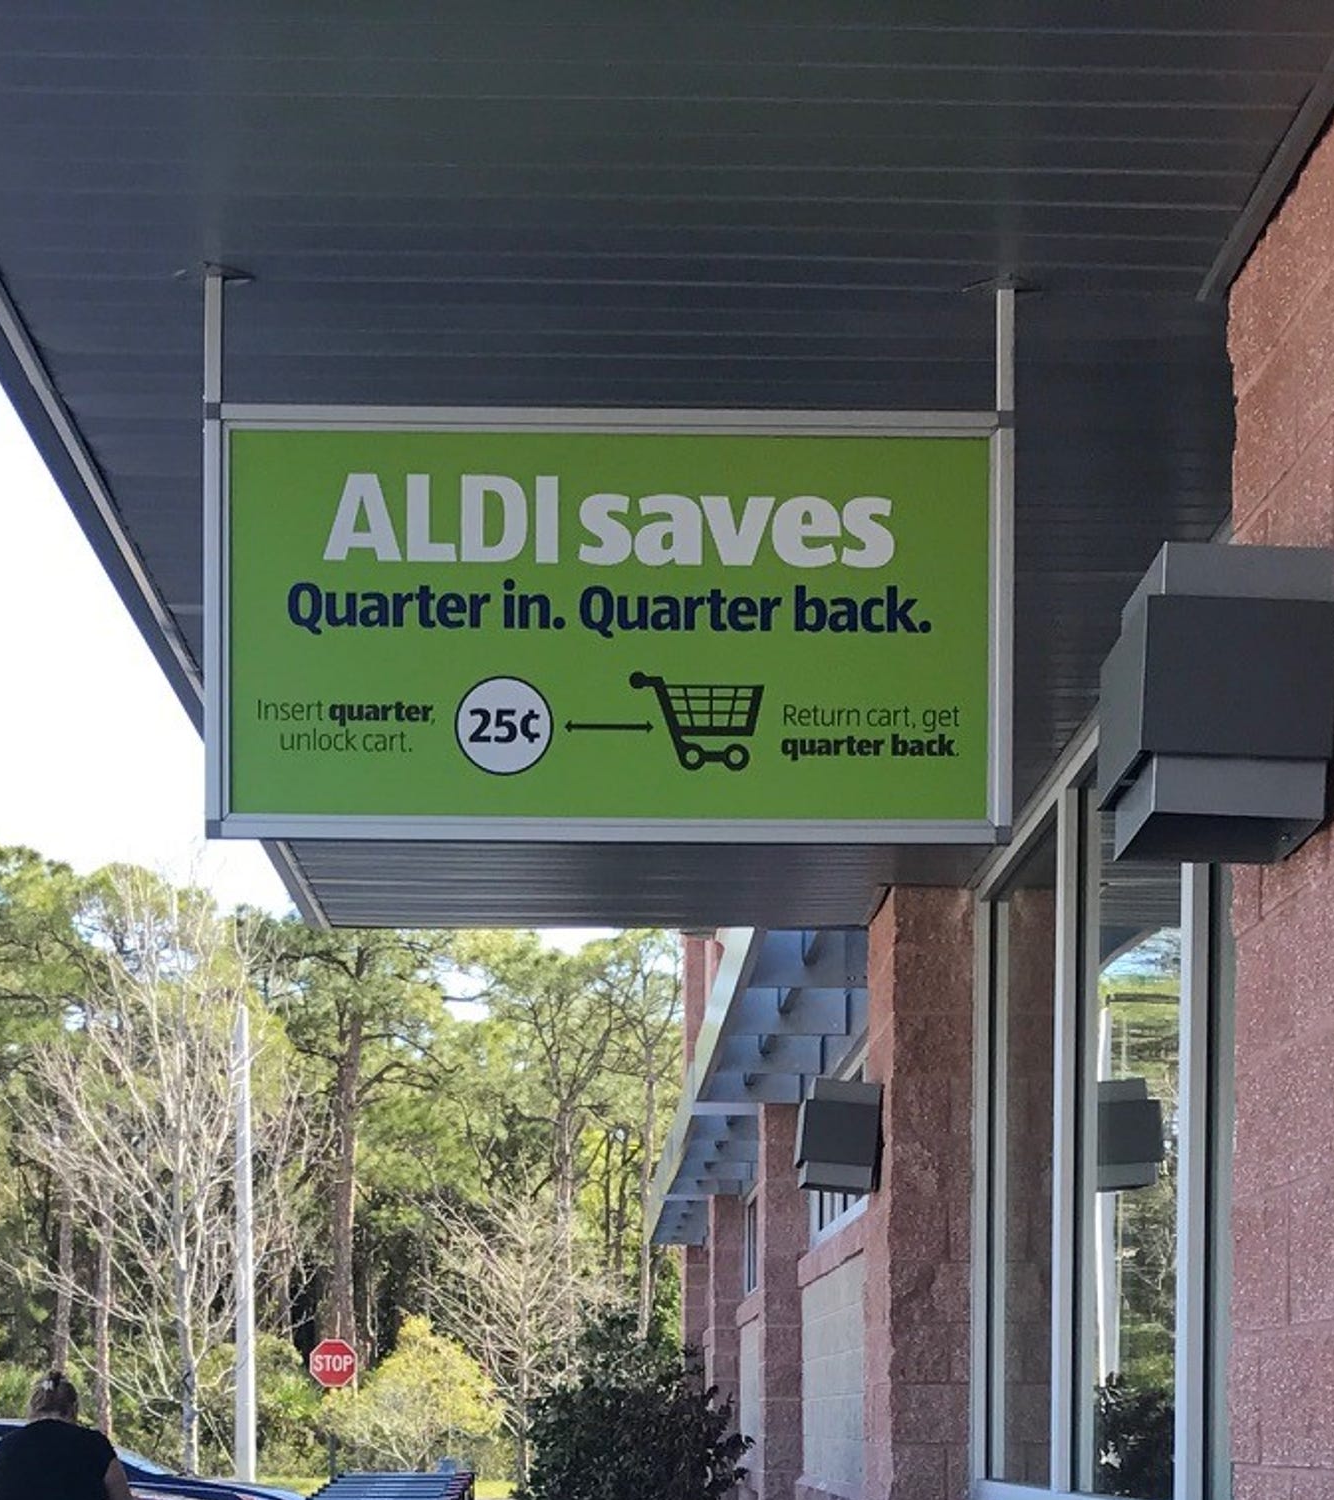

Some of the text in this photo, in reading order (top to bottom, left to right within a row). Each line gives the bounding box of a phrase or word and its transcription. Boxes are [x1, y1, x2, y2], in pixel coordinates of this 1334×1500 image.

[323, 473, 895, 568] ALDI saves
[287, 579, 932, 639] Quarter in. Quarter back.
[257, 700, 436, 727] Insert quarter,
[469, 708, 541, 743] 25¢
[783, 704, 960, 733] Return cart, get
[280, 729, 413, 752] unlock cart.
[781, 734, 960, 762] quarter back.
[314, 1354, 354, 1372] STOP
